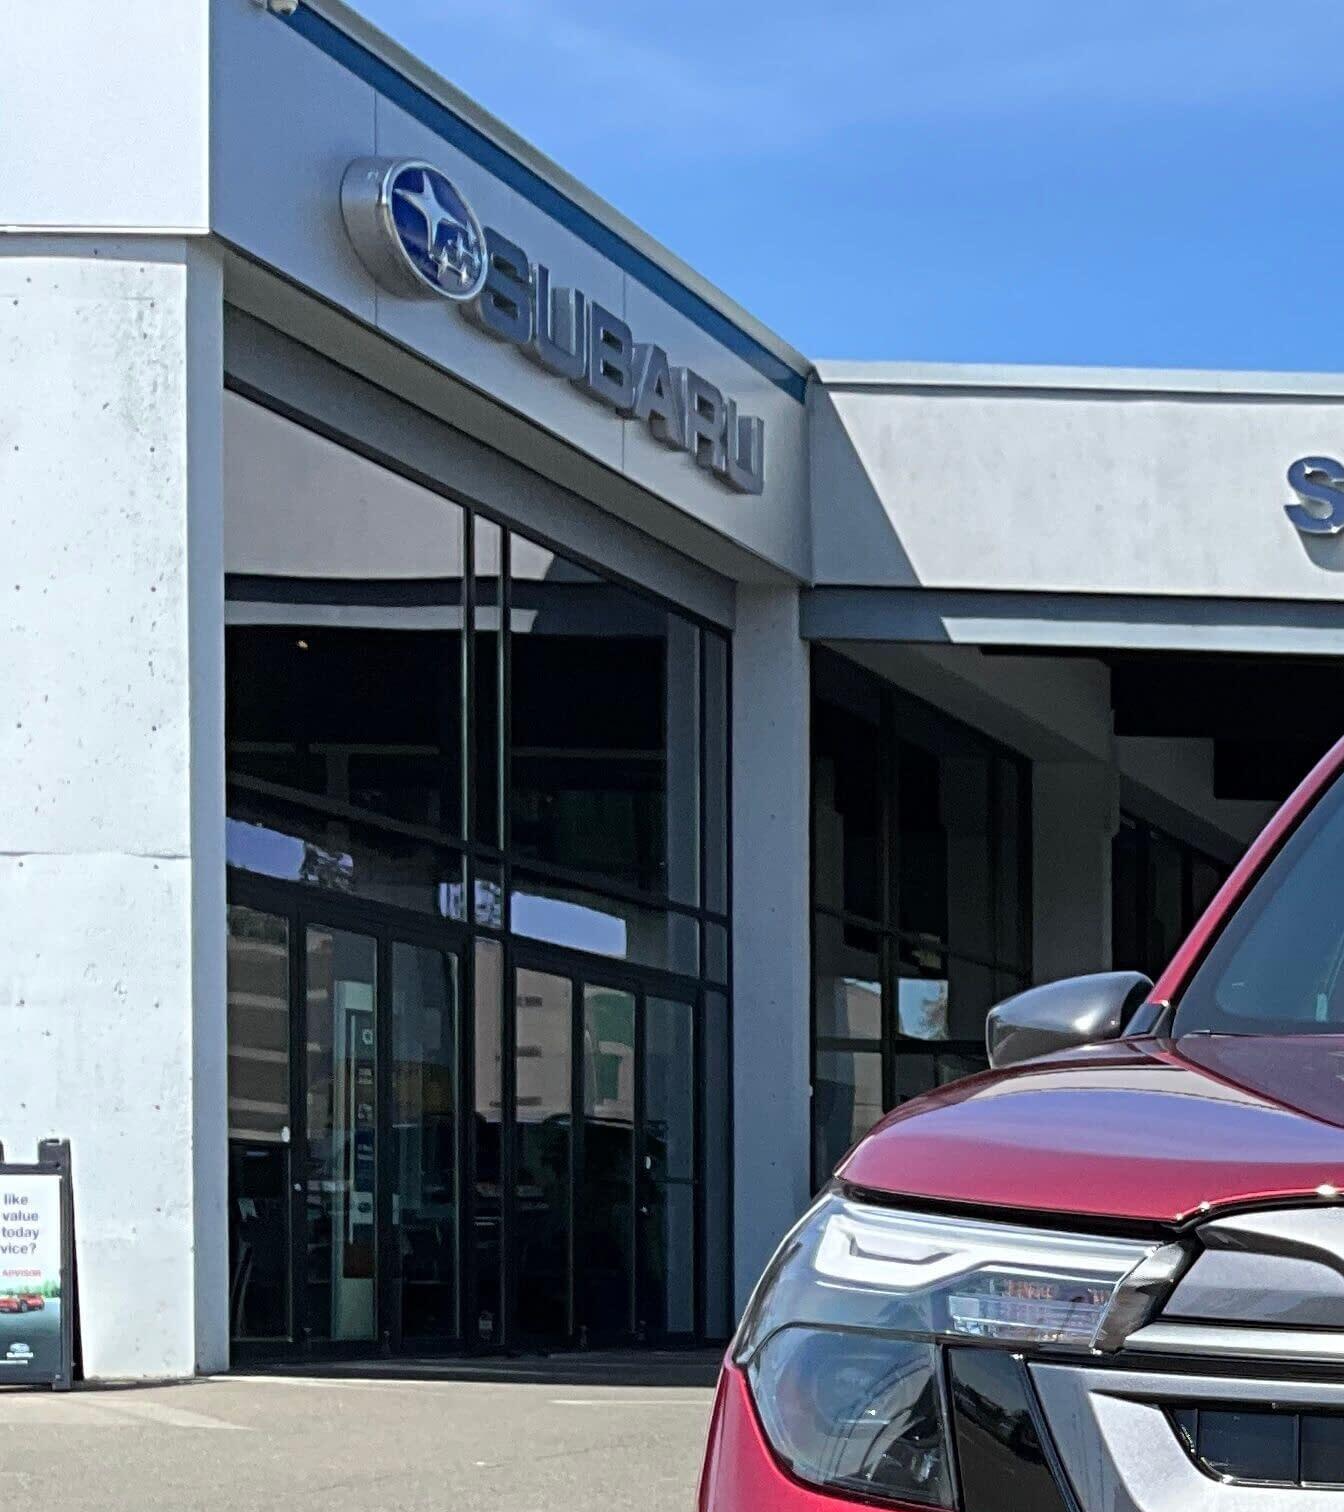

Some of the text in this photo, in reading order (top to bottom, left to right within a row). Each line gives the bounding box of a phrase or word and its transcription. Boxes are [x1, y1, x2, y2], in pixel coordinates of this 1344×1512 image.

[474, 226, 765, 495] SUBARU
[4, 1192, 29, 1206] like
[2, 1209, 40, 1222] value
[1, 1226, 40, 1241] today
